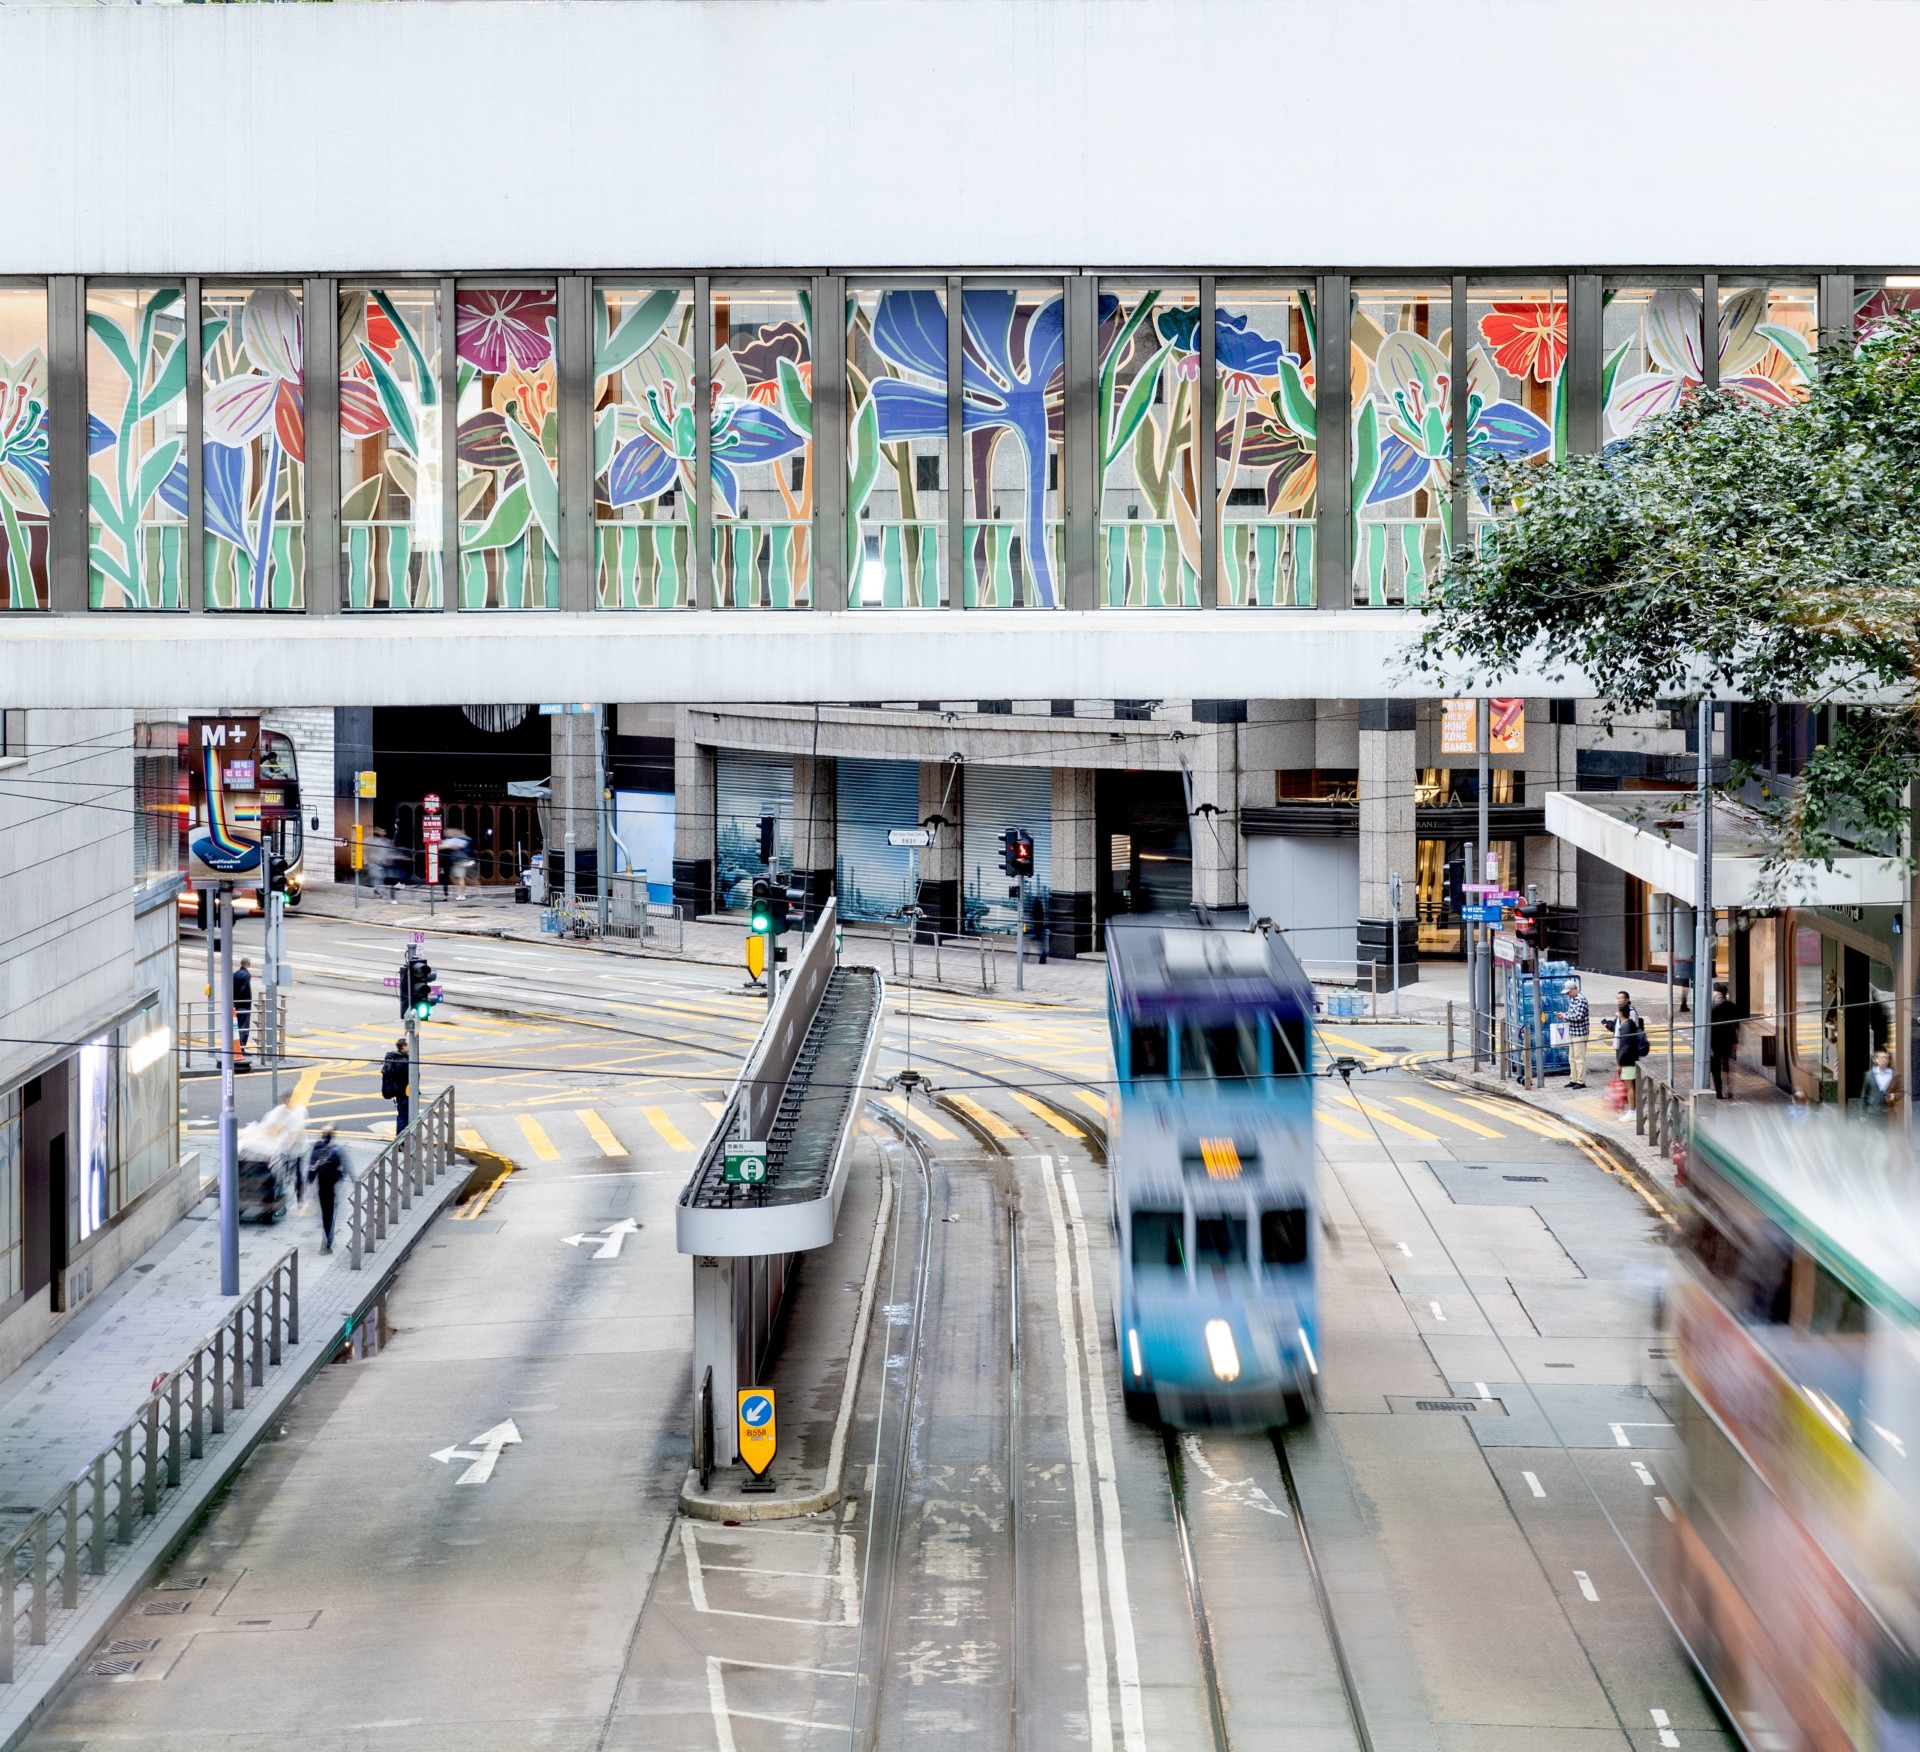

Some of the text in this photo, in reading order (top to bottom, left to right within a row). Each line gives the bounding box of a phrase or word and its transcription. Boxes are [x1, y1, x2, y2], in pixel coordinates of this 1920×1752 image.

[1444, 721, 1467, 731] HONG
[201, 724, 247, 746] M+
[1444, 732, 1467, 741] KONG
[1444, 742, 1473, 752] GAMES
[264, 791, 281, 803] 601P
[746, 1429, 766, 1437] B558
